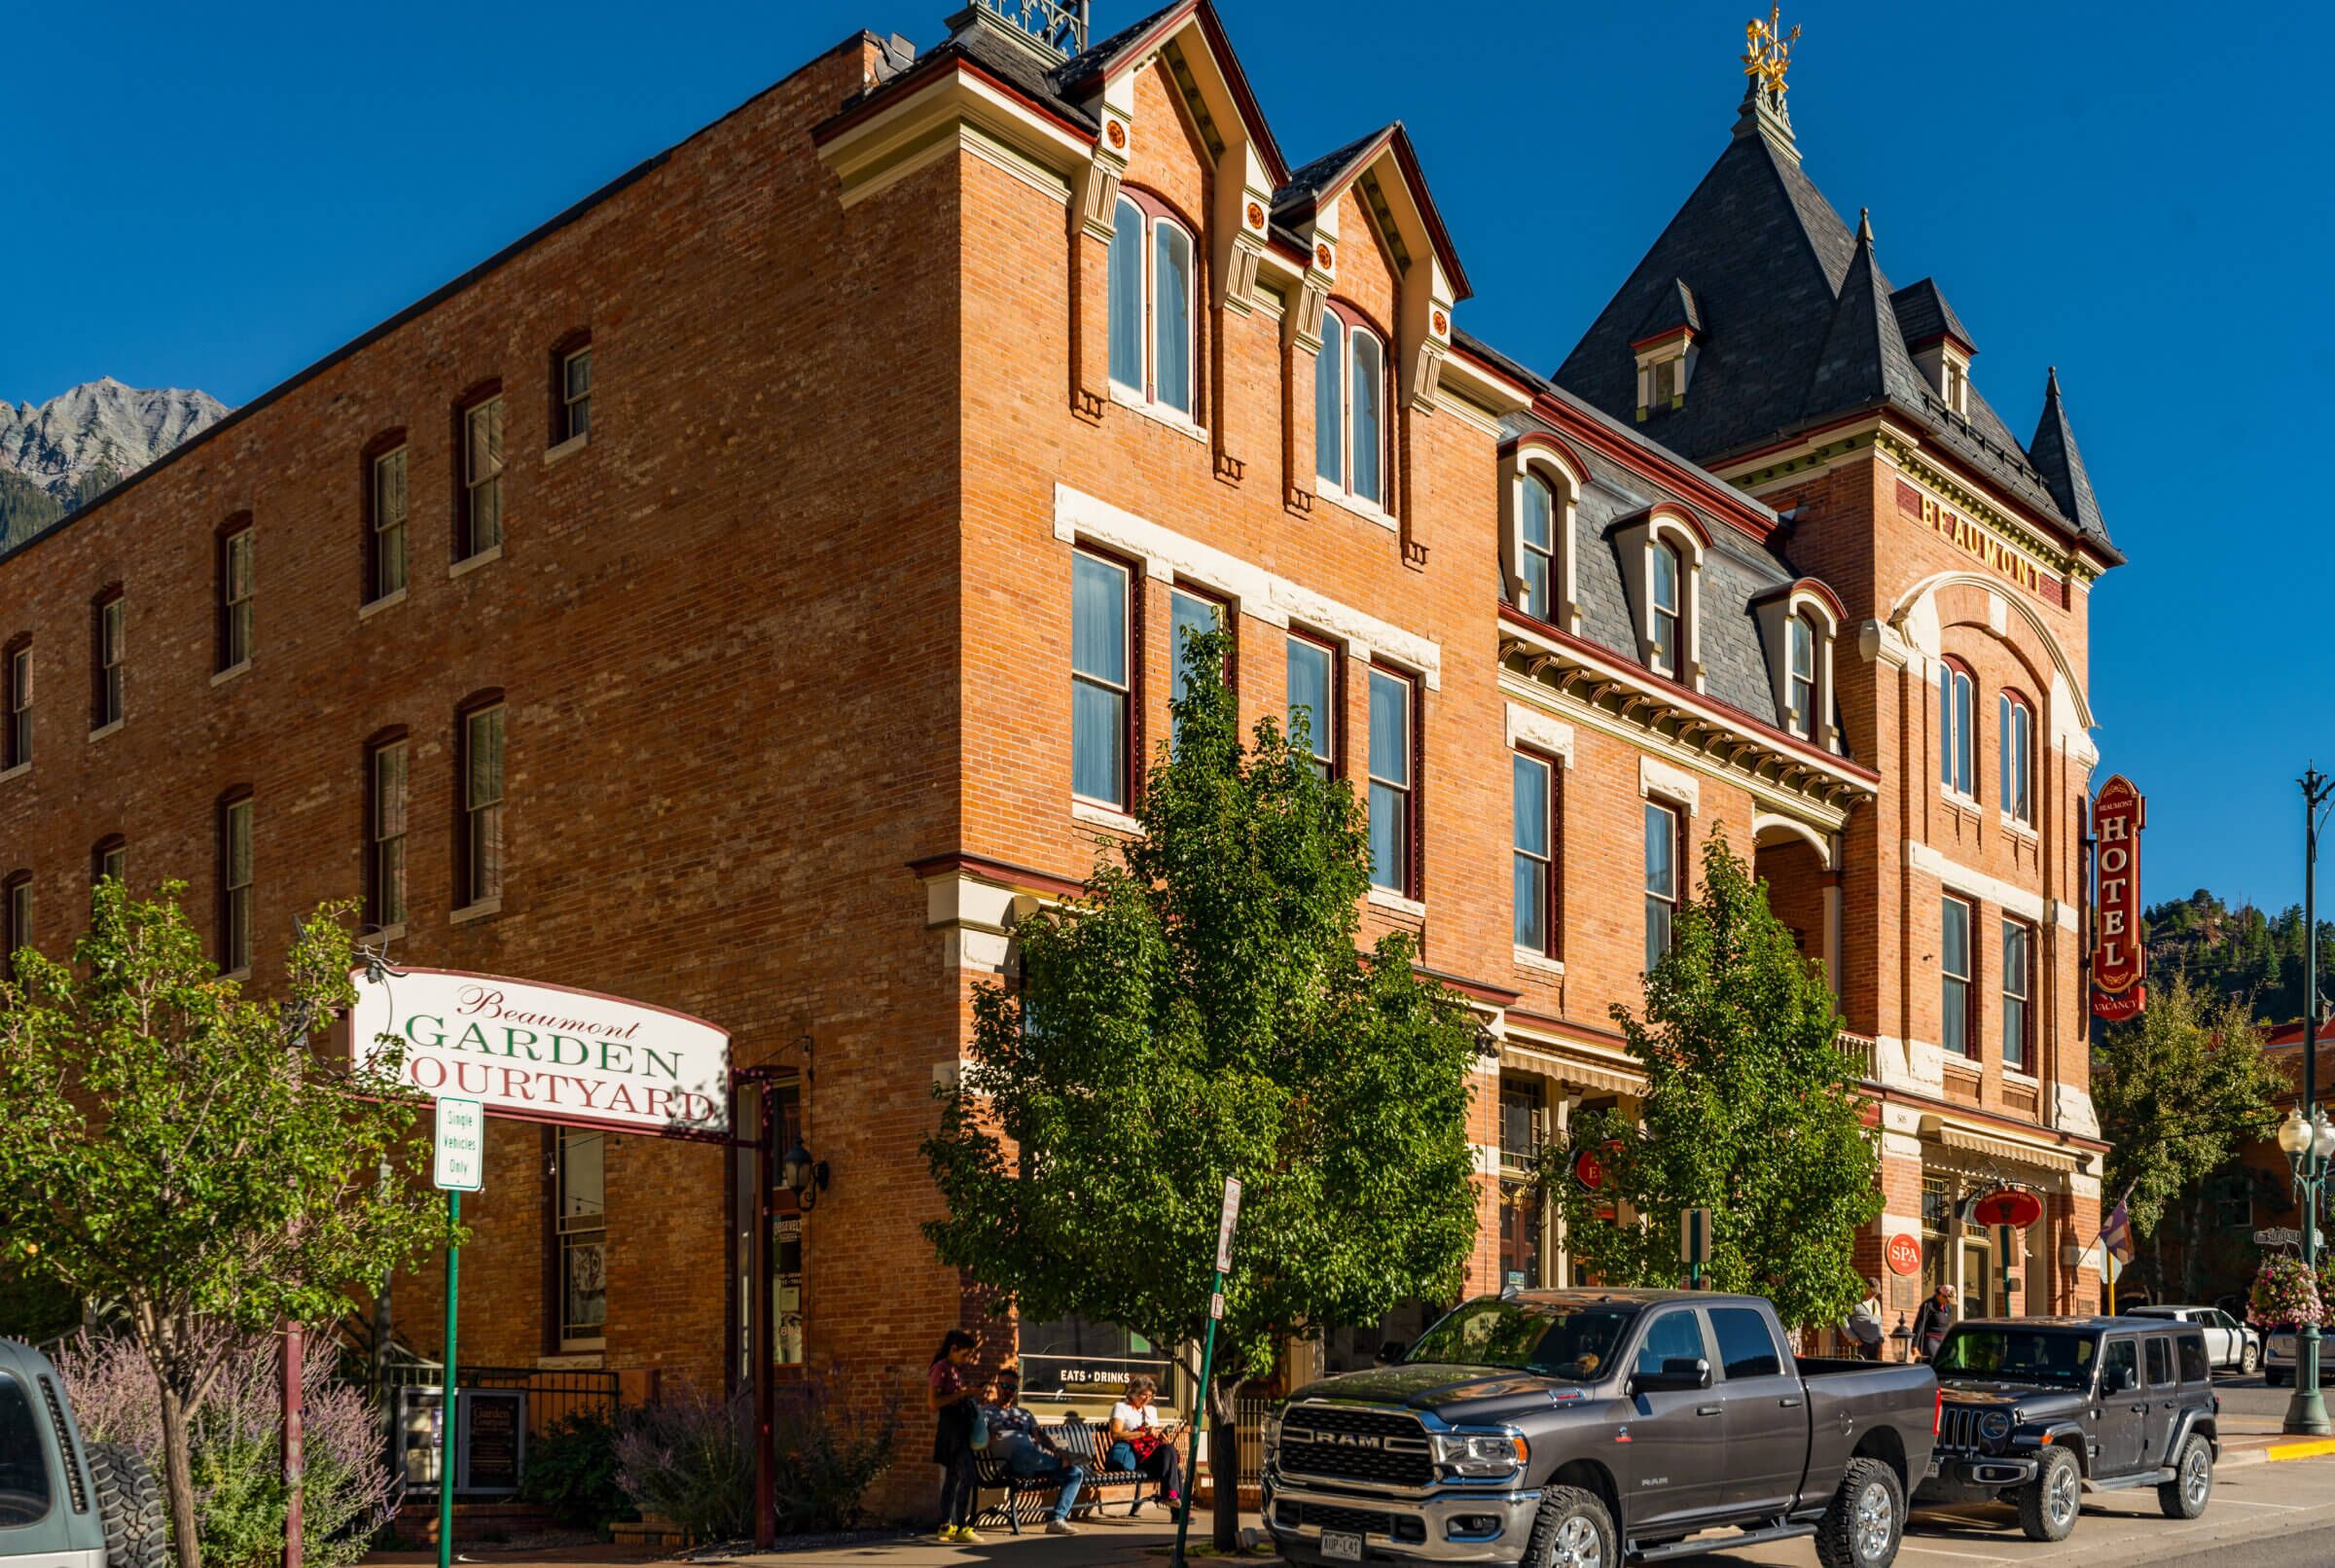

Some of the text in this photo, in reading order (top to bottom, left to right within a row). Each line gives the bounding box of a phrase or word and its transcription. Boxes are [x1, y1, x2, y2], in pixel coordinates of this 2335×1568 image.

[1921, 493, 2043, 594] BEAUMONT
[2099, 801, 2134, 811] BEAUMONT
[2100, 815, 2129, 967] HOTEL
[457, 984, 642, 1040] Beaumont
[2094, 999, 2137, 1012] VACANCY
[405, 1014, 684, 1081] GARDEN
[447, 1111, 473, 1128] Single
[444, 1135, 476, 1151] Vehicles
[449, 1158, 468, 1176] Only
[1891, 1245, 1919, 1263] SPA
[1060, 1370, 1131, 1384] EATS DRINKS
[1316, 1431, 1380, 1447] RAM
[1641, 1477, 1669, 1487] RAM
